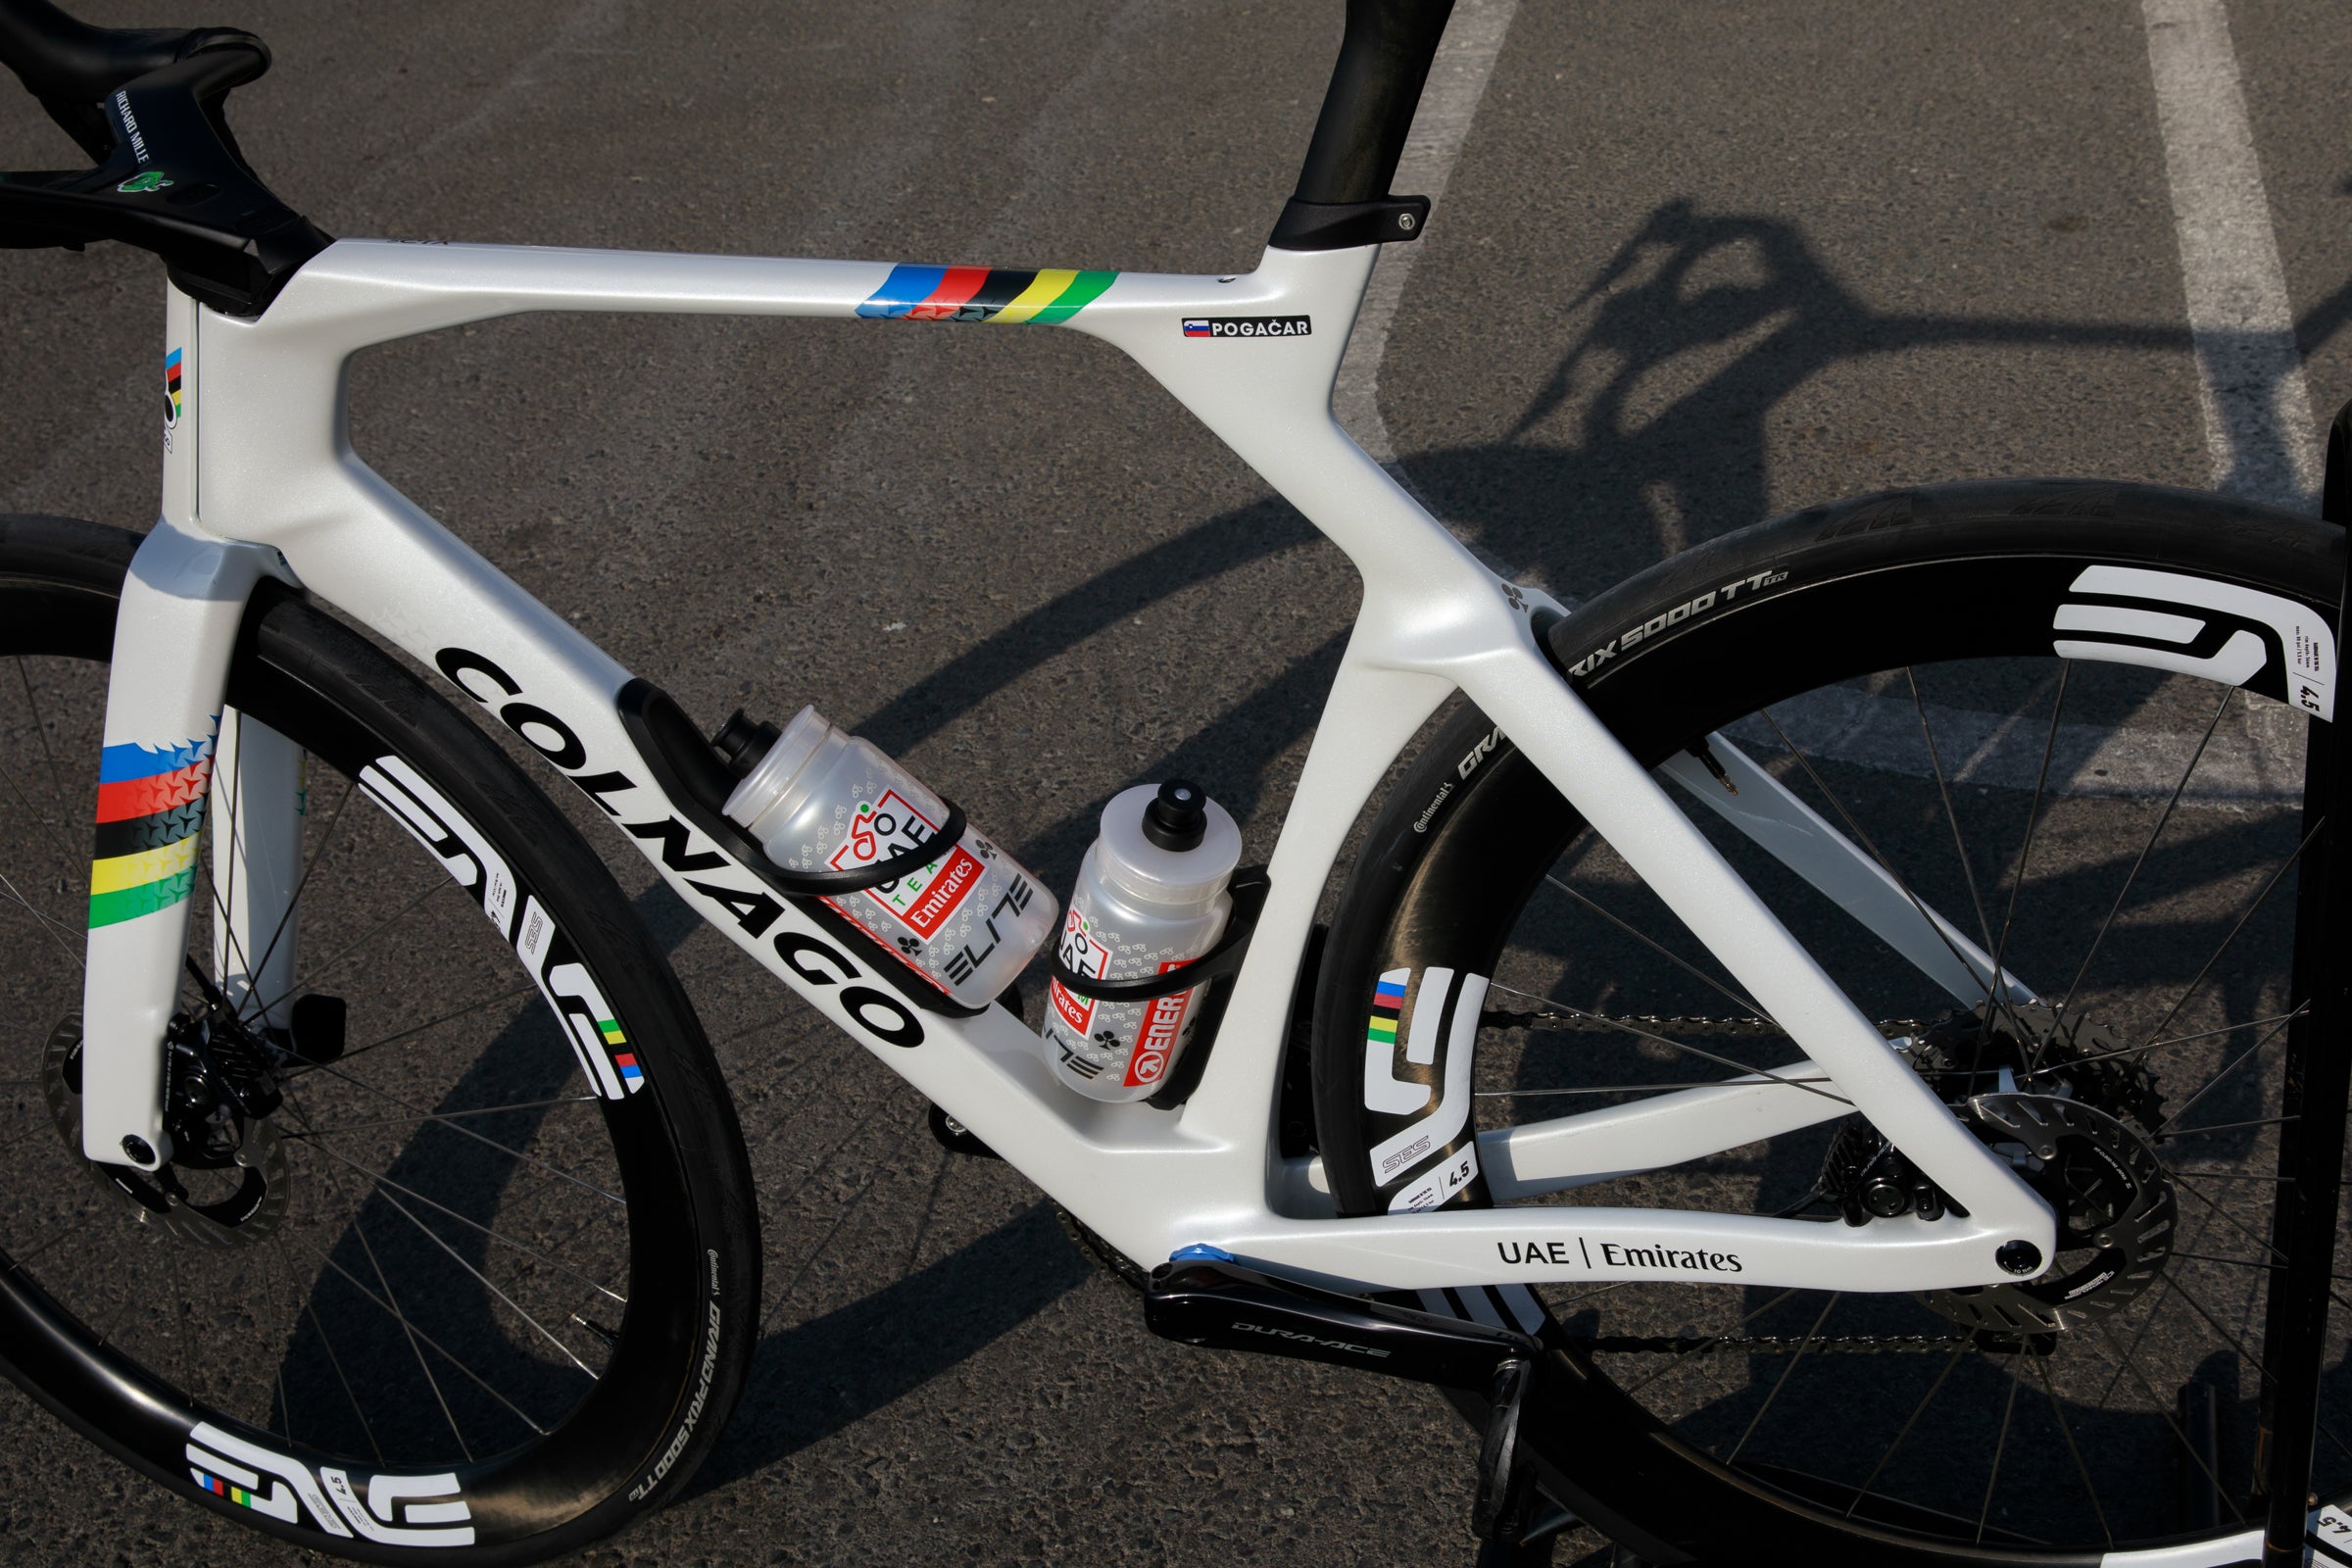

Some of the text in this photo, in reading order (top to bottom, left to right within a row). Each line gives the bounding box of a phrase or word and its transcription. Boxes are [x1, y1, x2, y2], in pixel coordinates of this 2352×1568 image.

[116, 90, 149, 164] RICHARD MILLE
[1211, 318, 1308, 336] POGAČAR
[1568, 639, 1616, 676] RIX
[1621, 591, 1716, 651] 5000
[1721, 570, 1772, 600] TT
[2300, 685, 2321, 711] 4.5
[1413, 725, 1507, 833] Continental GRA
[434, 647, 925, 1048] COLNAGO
[892, 852, 947, 906] TEA
[910, 858, 973, 928] Emirates
[943, 872, 1034, 987] ELITE
[1383, 1135, 1432, 1174] SES
[1448, 1160, 1470, 1187] 4.5
[707, 1249, 720, 1291] Continental
[1496, 1242, 1742, 1272] UAE Emirates
[702, 1299, 721, 1384] GRAND
[1231, 1322, 1392, 1359] DURA-ACE
[684, 1384, 710, 1433] PRIX
[654, 1427, 690, 1481] 5000
[330, 1475, 348, 1496] 4.5
[2316, 1515, 2352, 1535] 4.5
